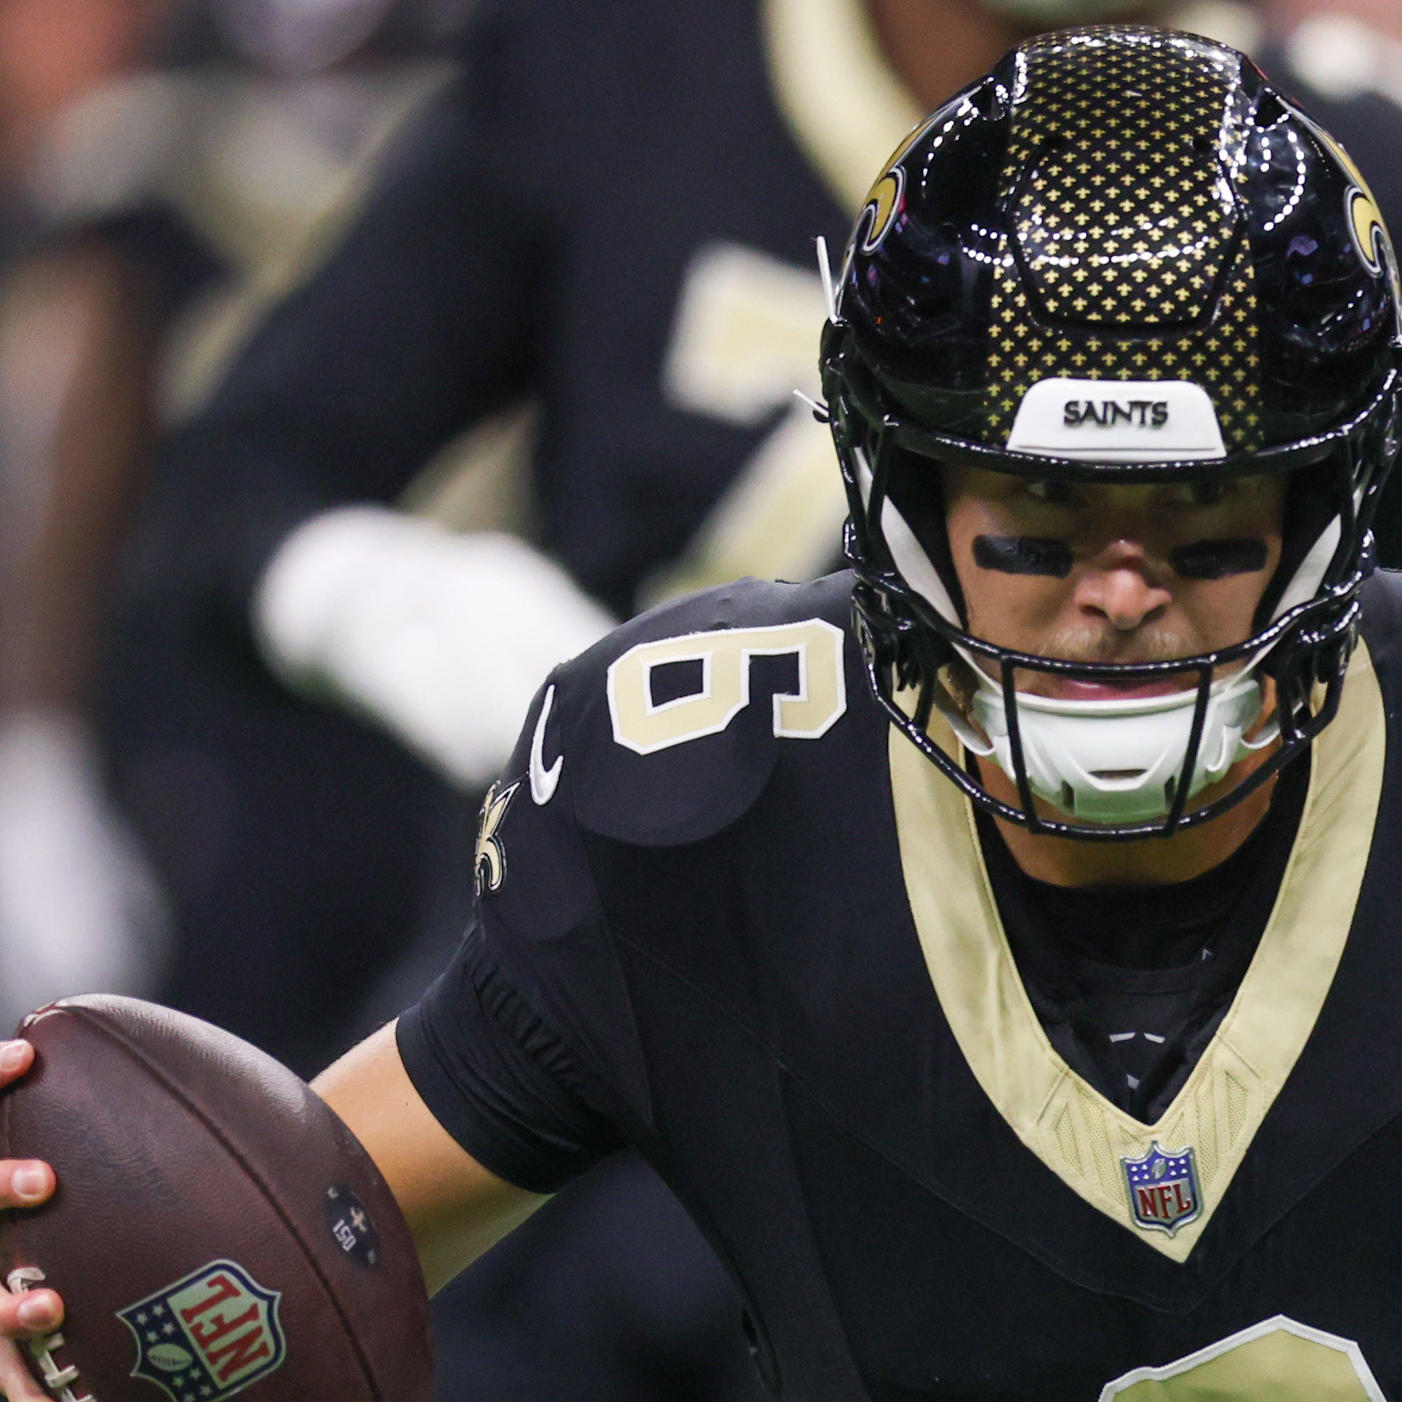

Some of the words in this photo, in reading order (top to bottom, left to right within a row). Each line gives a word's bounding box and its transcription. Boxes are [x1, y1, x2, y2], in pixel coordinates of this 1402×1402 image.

[1063, 399, 1169, 427] SAINTS
[606, 617, 848, 757] 6
[1137, 1183, 1192, 1219] NFL
[179, 1273, 271, 1383] NFL
